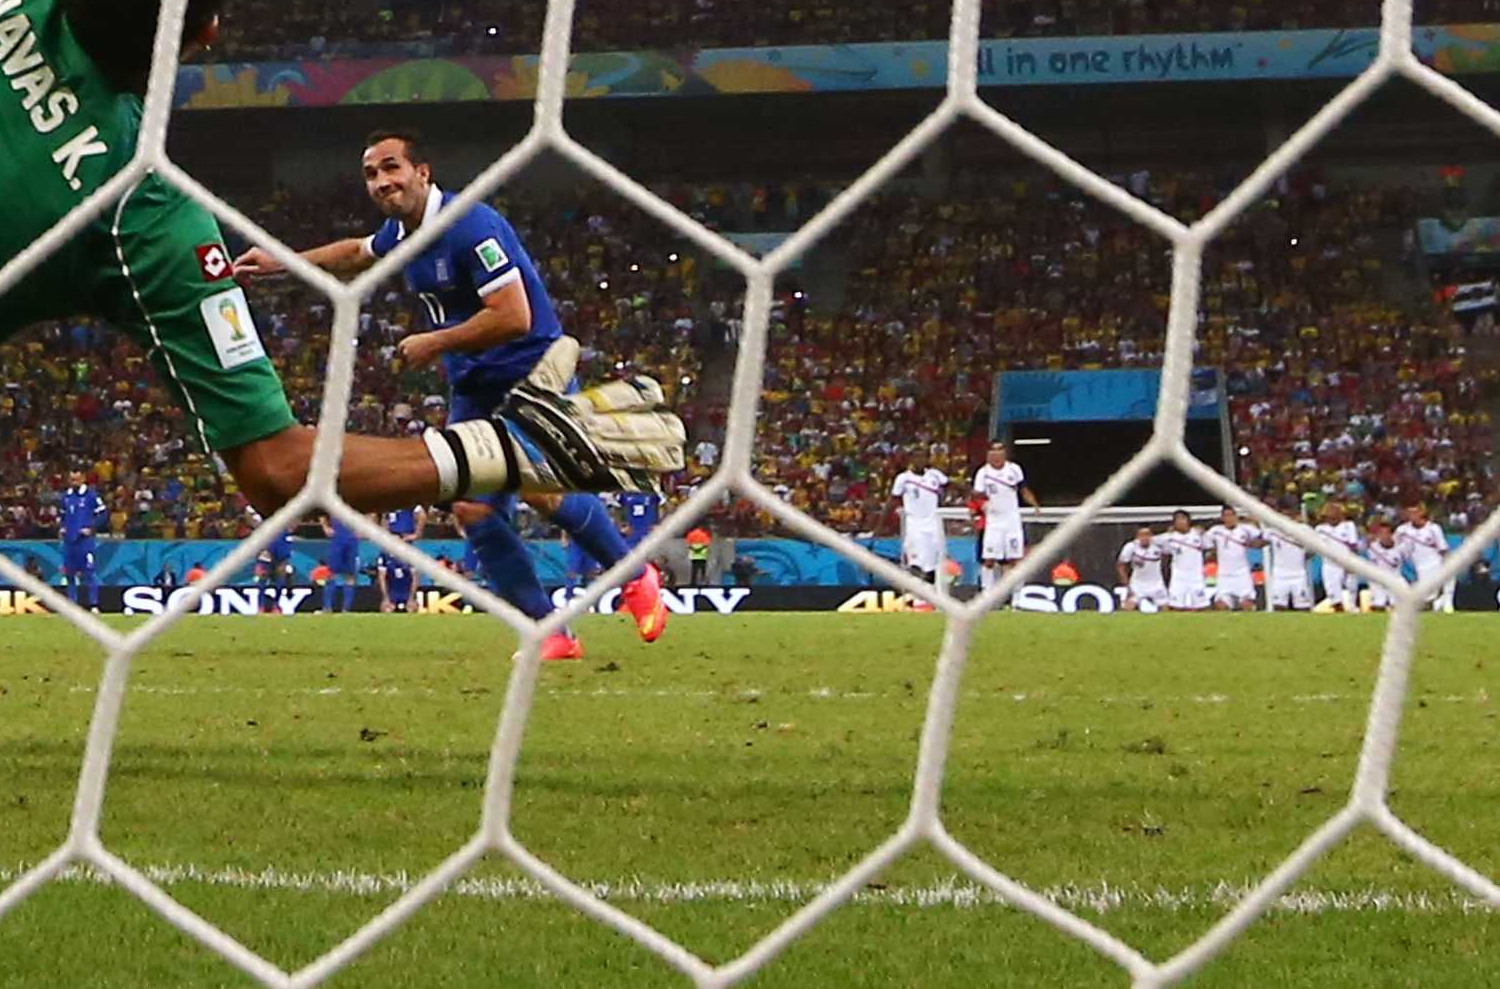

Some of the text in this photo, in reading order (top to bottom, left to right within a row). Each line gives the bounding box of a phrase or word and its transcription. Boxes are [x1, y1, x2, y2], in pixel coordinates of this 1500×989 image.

[1007, 47, 1036, 77] in
[1049, 49, 1111, 74] one
[52, 125, 108, 190] K.
[122, 586, 311, 615] SONY
